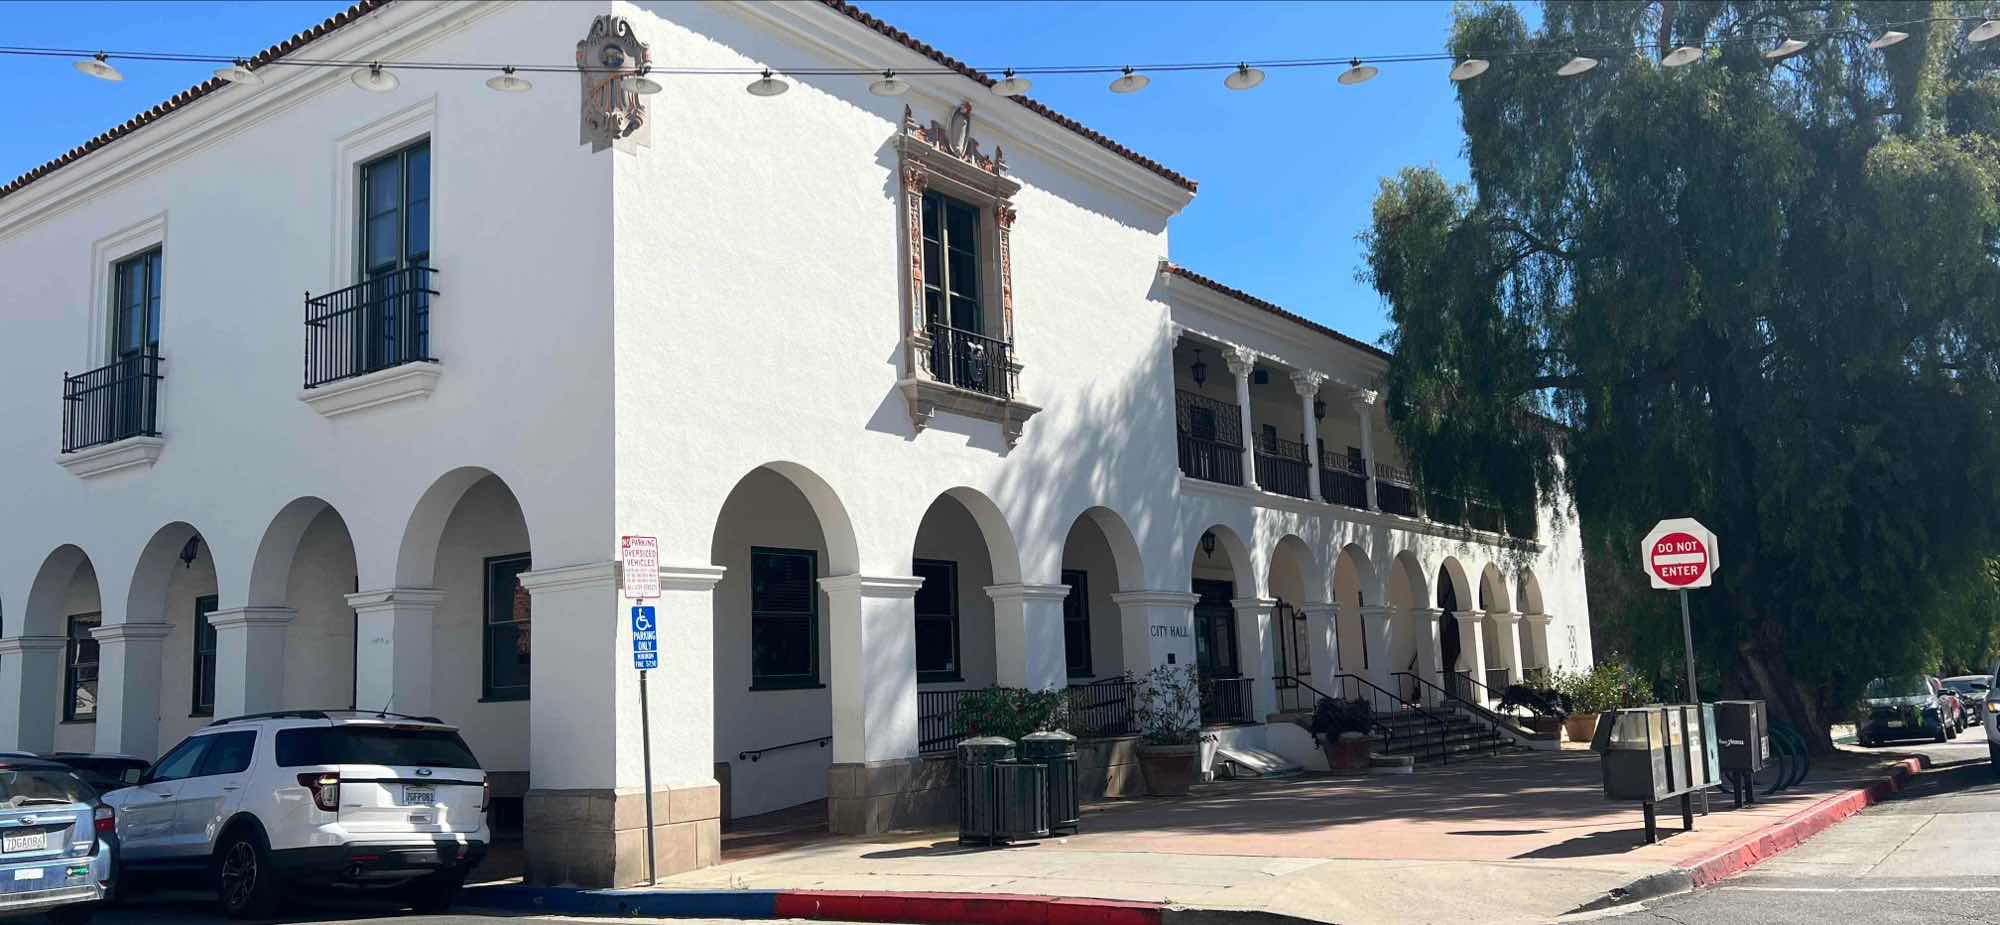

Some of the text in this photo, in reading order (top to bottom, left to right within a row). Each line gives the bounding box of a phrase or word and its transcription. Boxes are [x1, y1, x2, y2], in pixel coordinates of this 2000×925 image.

[623, 538, 655, 547] NO PARKING
[1658, 541, 1697, 553] DO NOT
[625, 549, 656, 557] OVERSIZED
[1662, 565, 1698, 577] ENTER
[633, 631, 656, 640] PARKING
[1151, 625, 1190, 638] CITY HALL
[638, 641, 652, 650] ONLY
